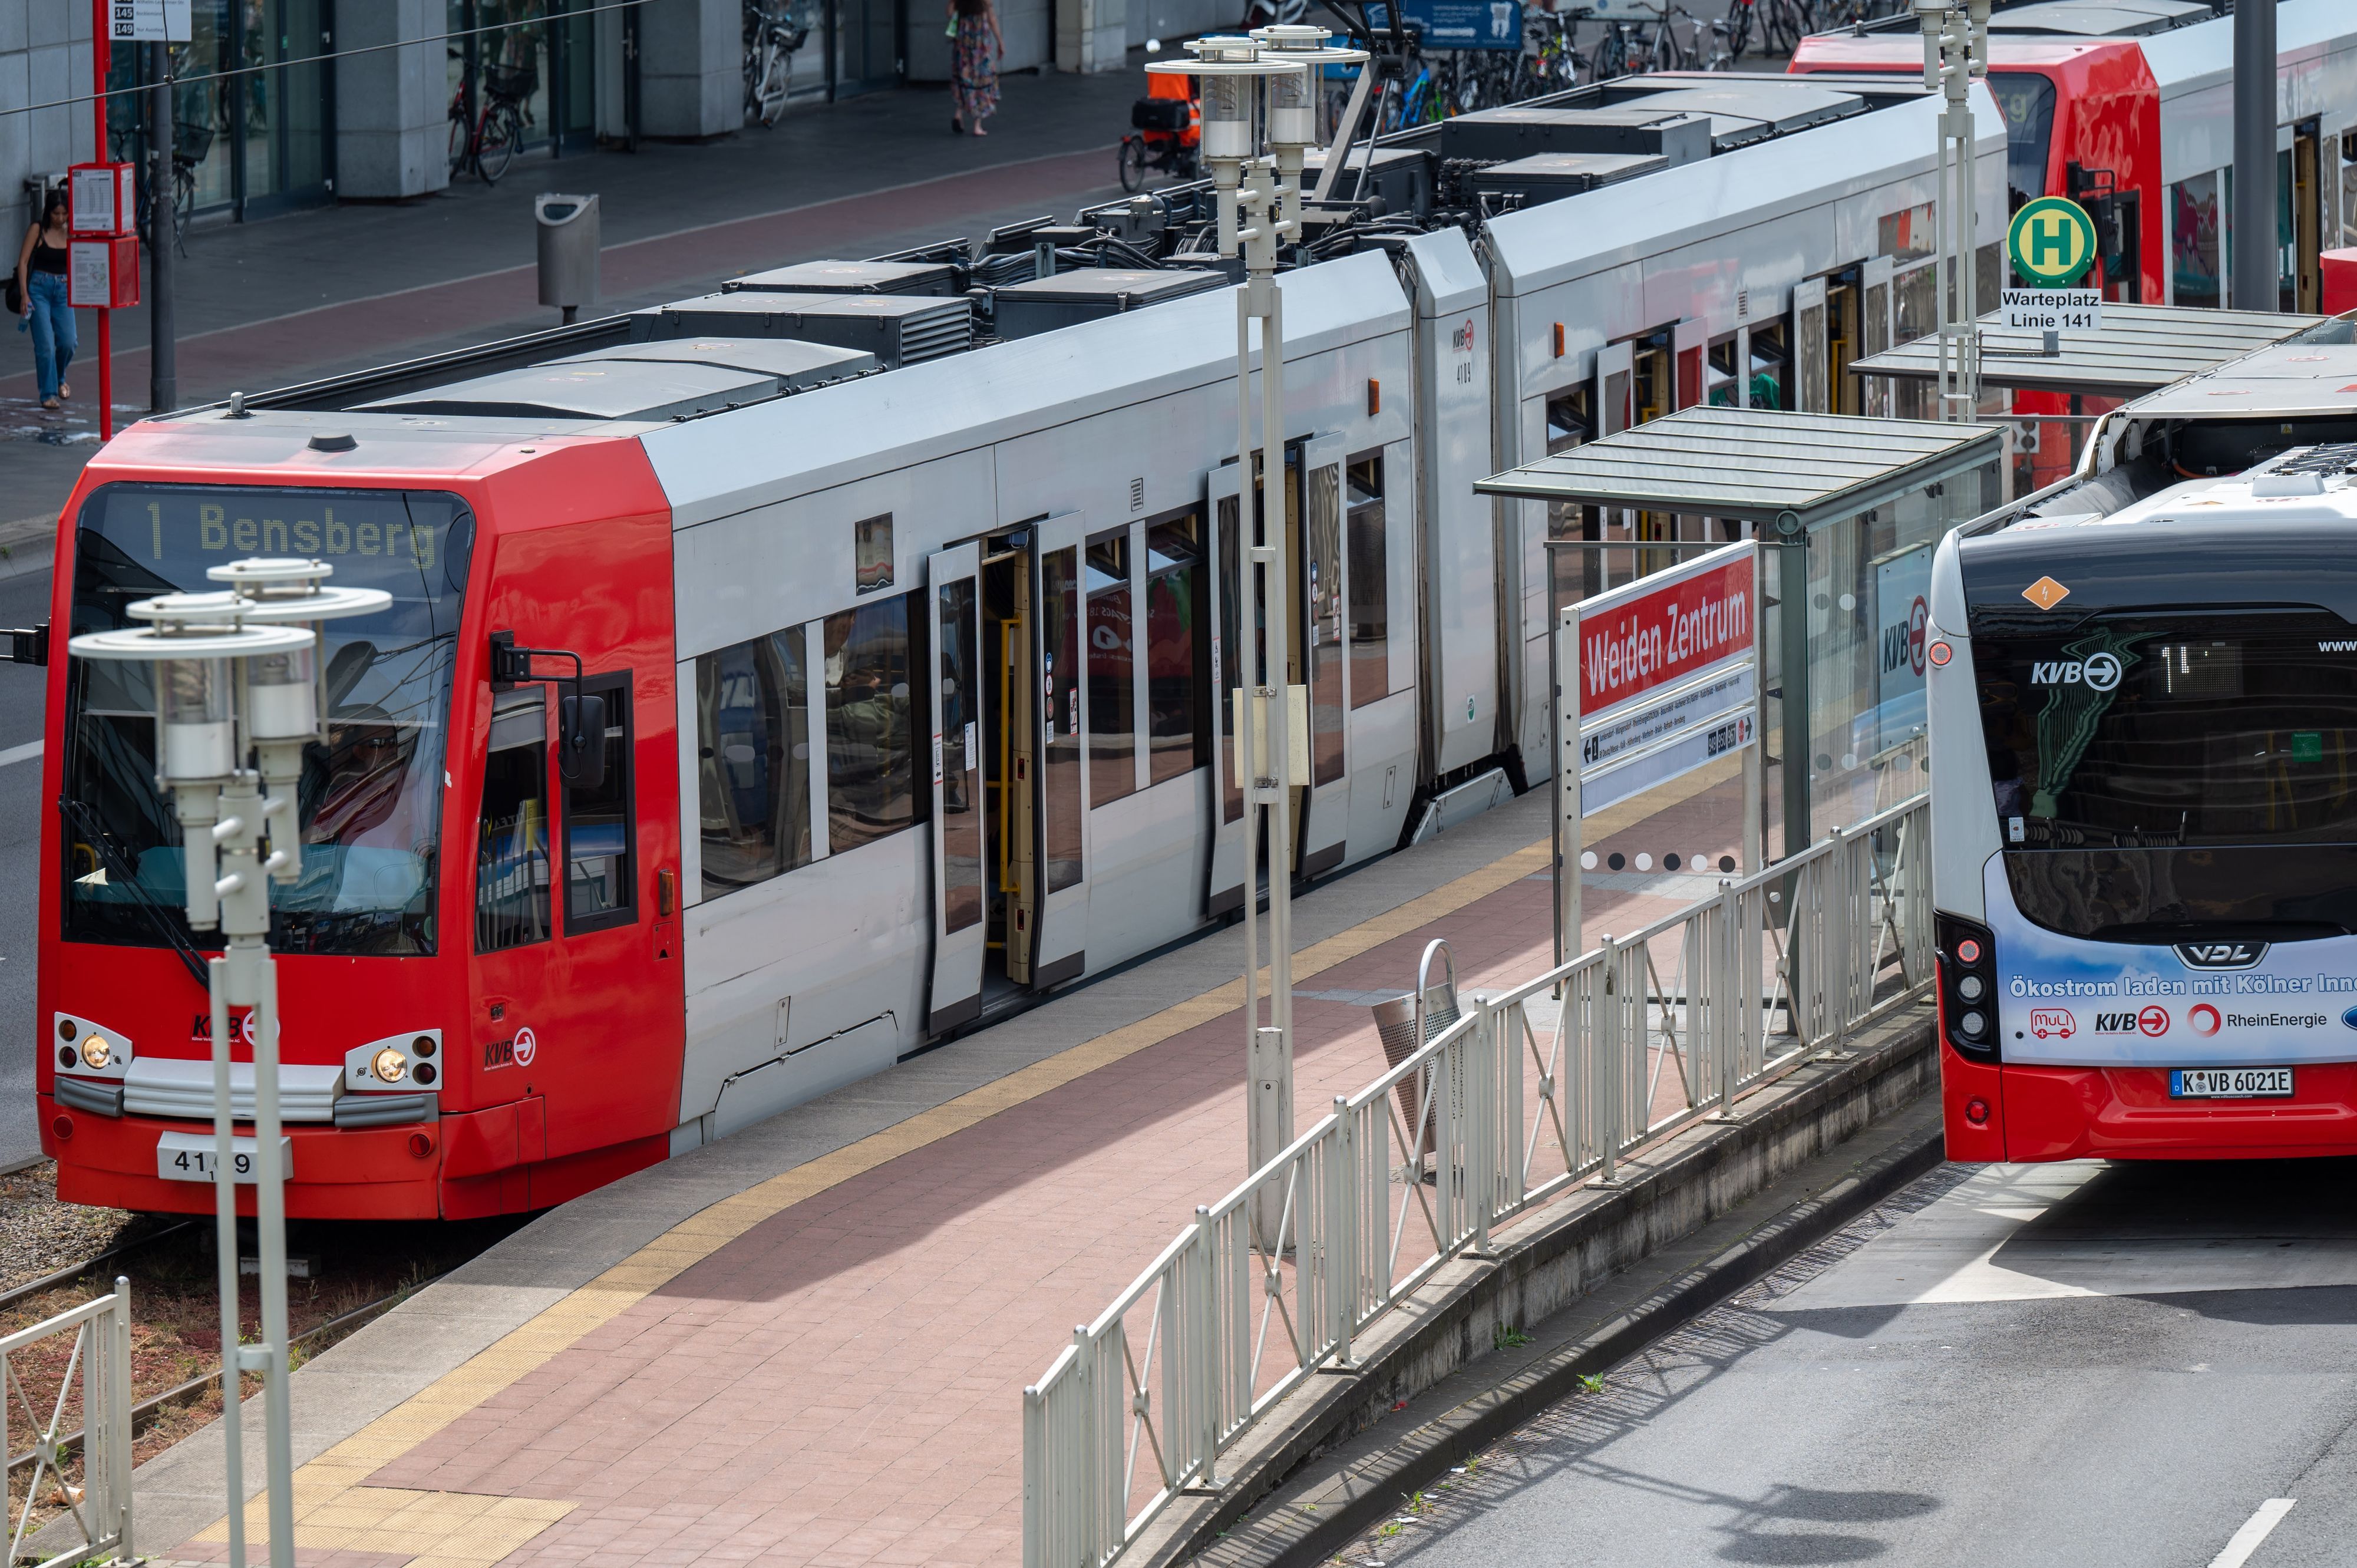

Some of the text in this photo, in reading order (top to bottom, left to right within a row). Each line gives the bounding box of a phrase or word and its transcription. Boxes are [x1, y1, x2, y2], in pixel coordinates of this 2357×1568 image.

[115, 8, 133, 18] 145
[115, 24, 133, 34] 149
[2002, 292, 2099, 309] Warteplatz
[2011, 313, 2091, 328] Linie 141
[1453, 329, 1465, 349] KVB
[1457, 362, 1471, 385] 4109
[147, 501, 435, 570] 1 Bensberg
[1587, 590, 1745, 696] Weiden Zentrum
[1884, 620, 1909, 674] KVB
[2031, 662, 2082, 684] KVB
[1599, 729, 1615, 742] Junkersdorf
[1615, 720, 1632, 734] Müngersdorf
[1633, 711, 1659, 727] RheinEnergieSTADION
[1661, 704, 1673, 715] Braunsfeld
[1675, 699, 1686, 709] Aachener
[1700, 687, 1714, 698] Rudolfplatz
[1715, 682, 1727, 692] Neumarkt
[1627, 734, 1641, 746] Höhenberg
[1642, 728, 1653, 737] Merheim
[1663, 720, 1673, 729] Refrath
[1674, 715, 1685, 725] Bensberg
[1708, 736, 1716, 753] 949
[1718, 731, 1726, 749] 950
[2188, 945, 2252, 962] VDL
[2009, 975, 2118, 998] Ökostrom
[2124, 976, 2186, 996] laden
[2193, 975, 2231, 995] mit
[2236, 974, 2312, 994] Kölner
[193, 1015, 242, 1037] KB
[2095, 1013, 2137, 1032] KVB
[2227, 1012, 2328, 1029] RheinEnergie
[484, 1039, 513, 1067] KVB
[2183, 1074, 2194, 1092] K
[2207, 1072, 2230, 1092] VB
[2234, 1072, 2289, 1091] 6021E
[174, 1151, 250, 1174] 419
